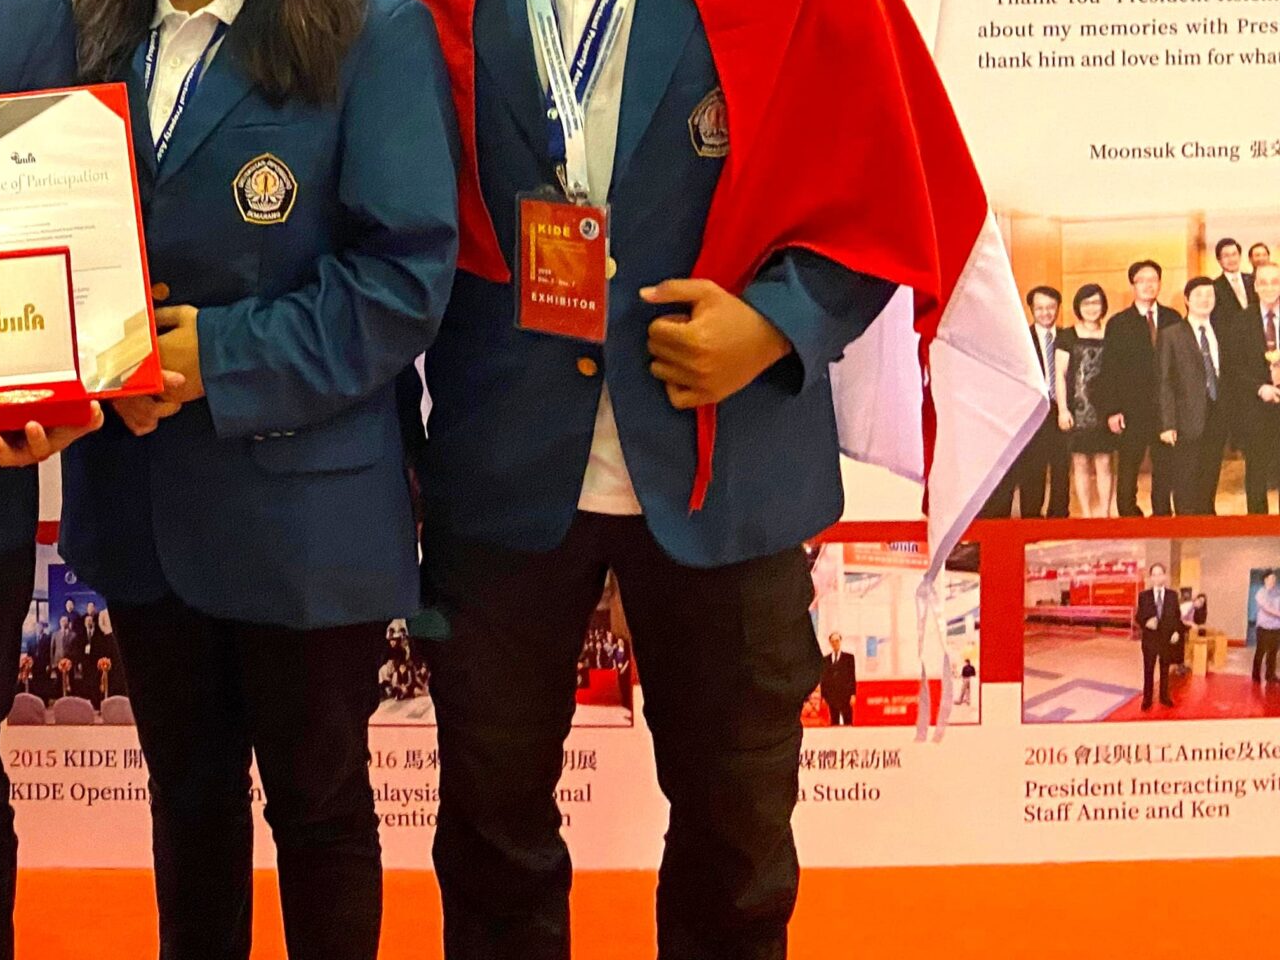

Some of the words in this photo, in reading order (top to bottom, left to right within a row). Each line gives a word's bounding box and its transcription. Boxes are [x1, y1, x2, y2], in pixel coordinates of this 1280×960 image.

[1090, 142, 1175, 159] Moonsuk
[1182, 142, 1240, 162] Chang
[10, 172, 23, 195] of
[26, 169, 111, 191] Participation
[537, 223, 571, 238] KIDE
[531, 291, 596, 311] EXHIBITOR
[10, 750, 57, 768] 2015
[64, 750, 117, 767] KIDE
[1026, 778, 1122, 798] President
[1132, 775, 1246, 797] Interacting
[1024, 803, 1072, 821] Staff
[1078, 804, 1139, 820] Annie
[1146, 800, 1183, 819] and
[1192, 801, 1229, 818] Ken
